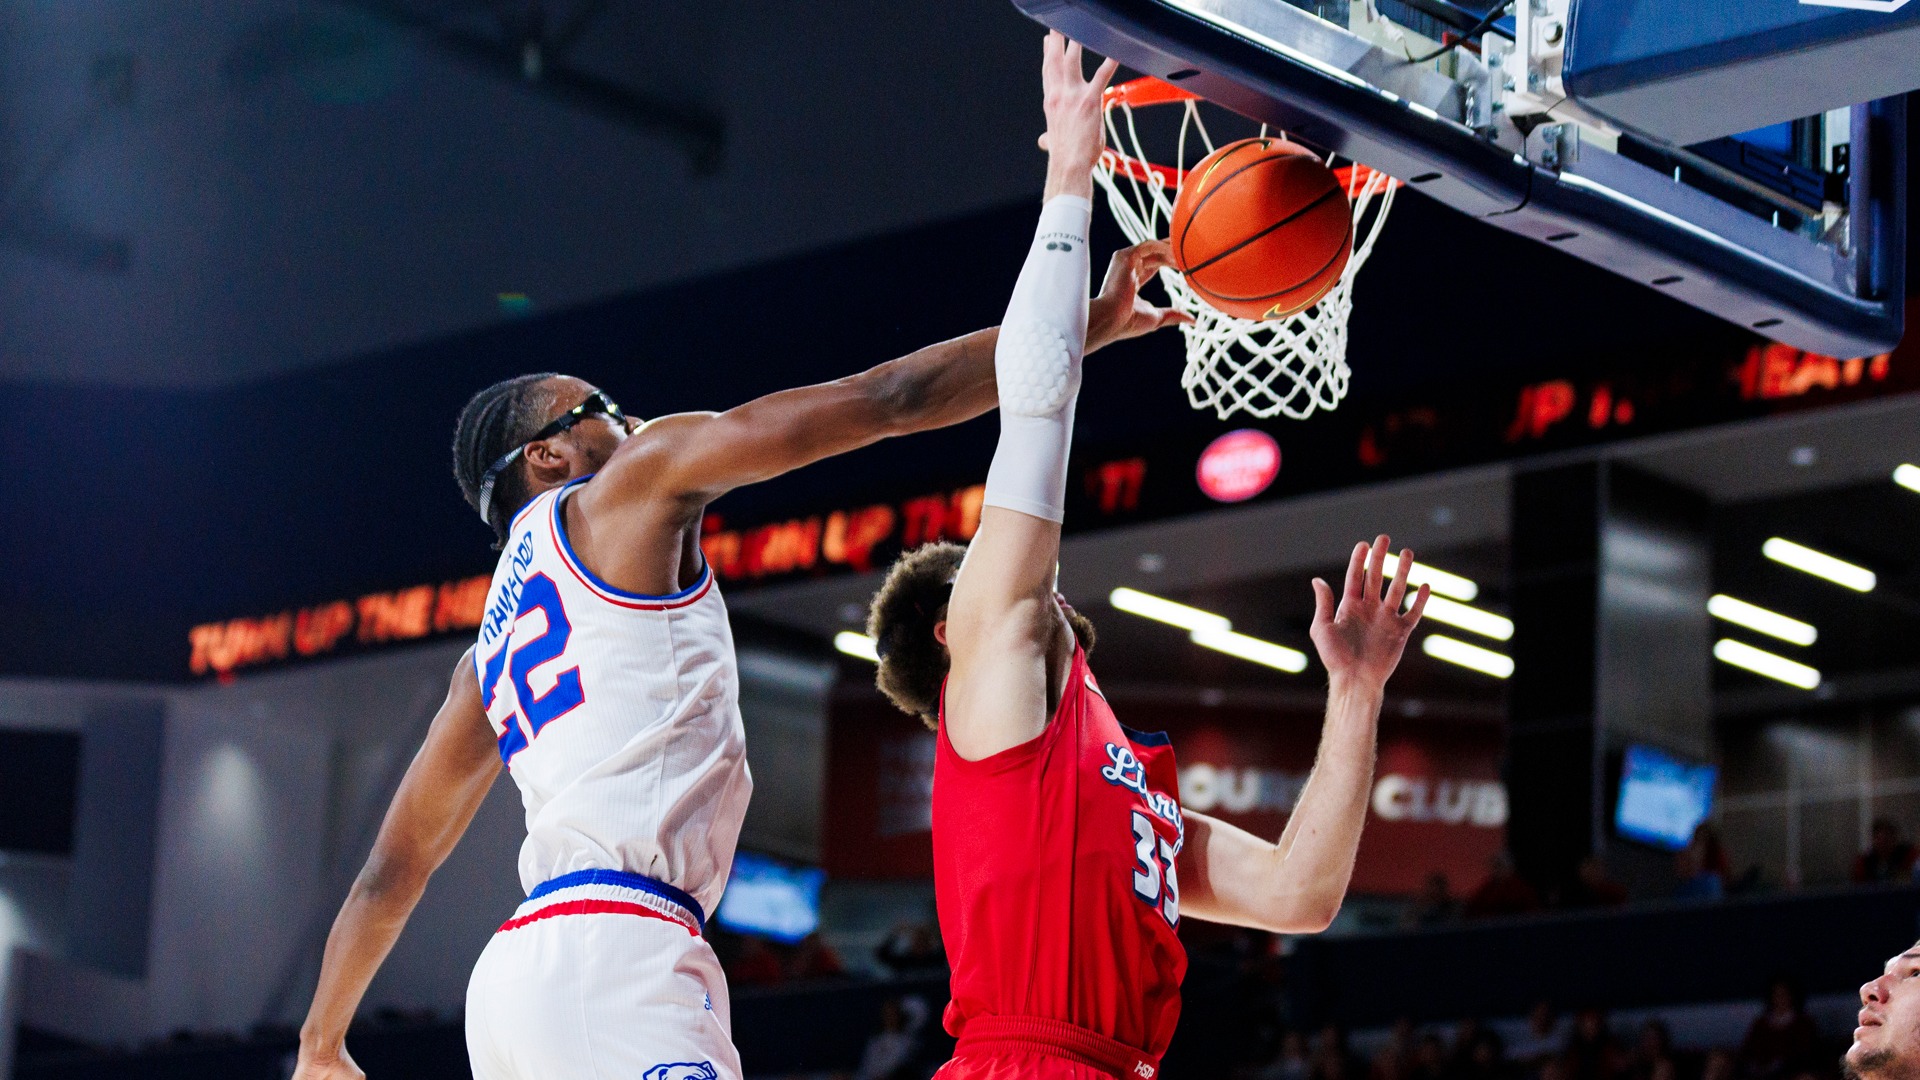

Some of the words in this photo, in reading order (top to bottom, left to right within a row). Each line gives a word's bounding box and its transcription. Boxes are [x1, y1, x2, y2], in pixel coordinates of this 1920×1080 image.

[1040, 231, 1084, 244] MUELLER
[483, 530, 533, 646] RAWFORD
[188, 616, 291, 675] TURN
[294, 600, 353, 656] UP
[482, 570, 586, 773] 22
[1372, 773, 1510, 827] CLUB
[1131, 809, 1180, 930] 33
